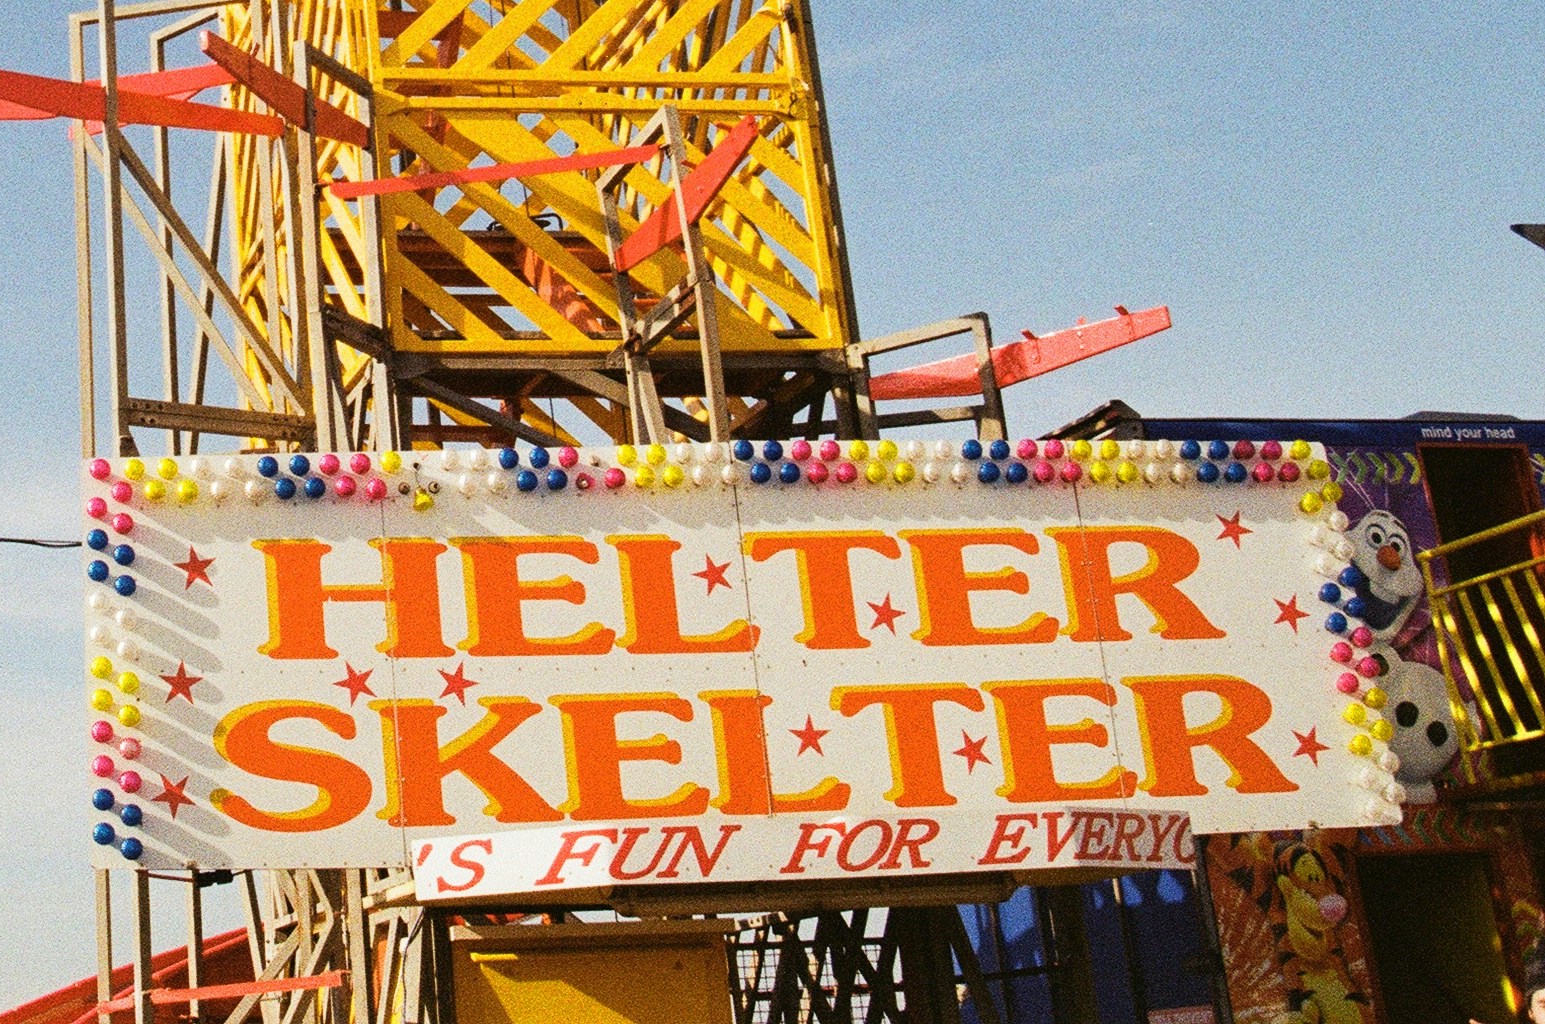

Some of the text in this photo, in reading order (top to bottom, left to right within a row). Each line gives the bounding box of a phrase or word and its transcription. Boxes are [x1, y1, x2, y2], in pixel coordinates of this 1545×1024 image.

[1421, 426, 1515, 441] mind your head
[250, 525, 1227, 660] HELTER
[210, 672, 1300, 833] SKELTER
[535, 824, 743, 886] FUN
[779, 818, 941, 874] FOR
